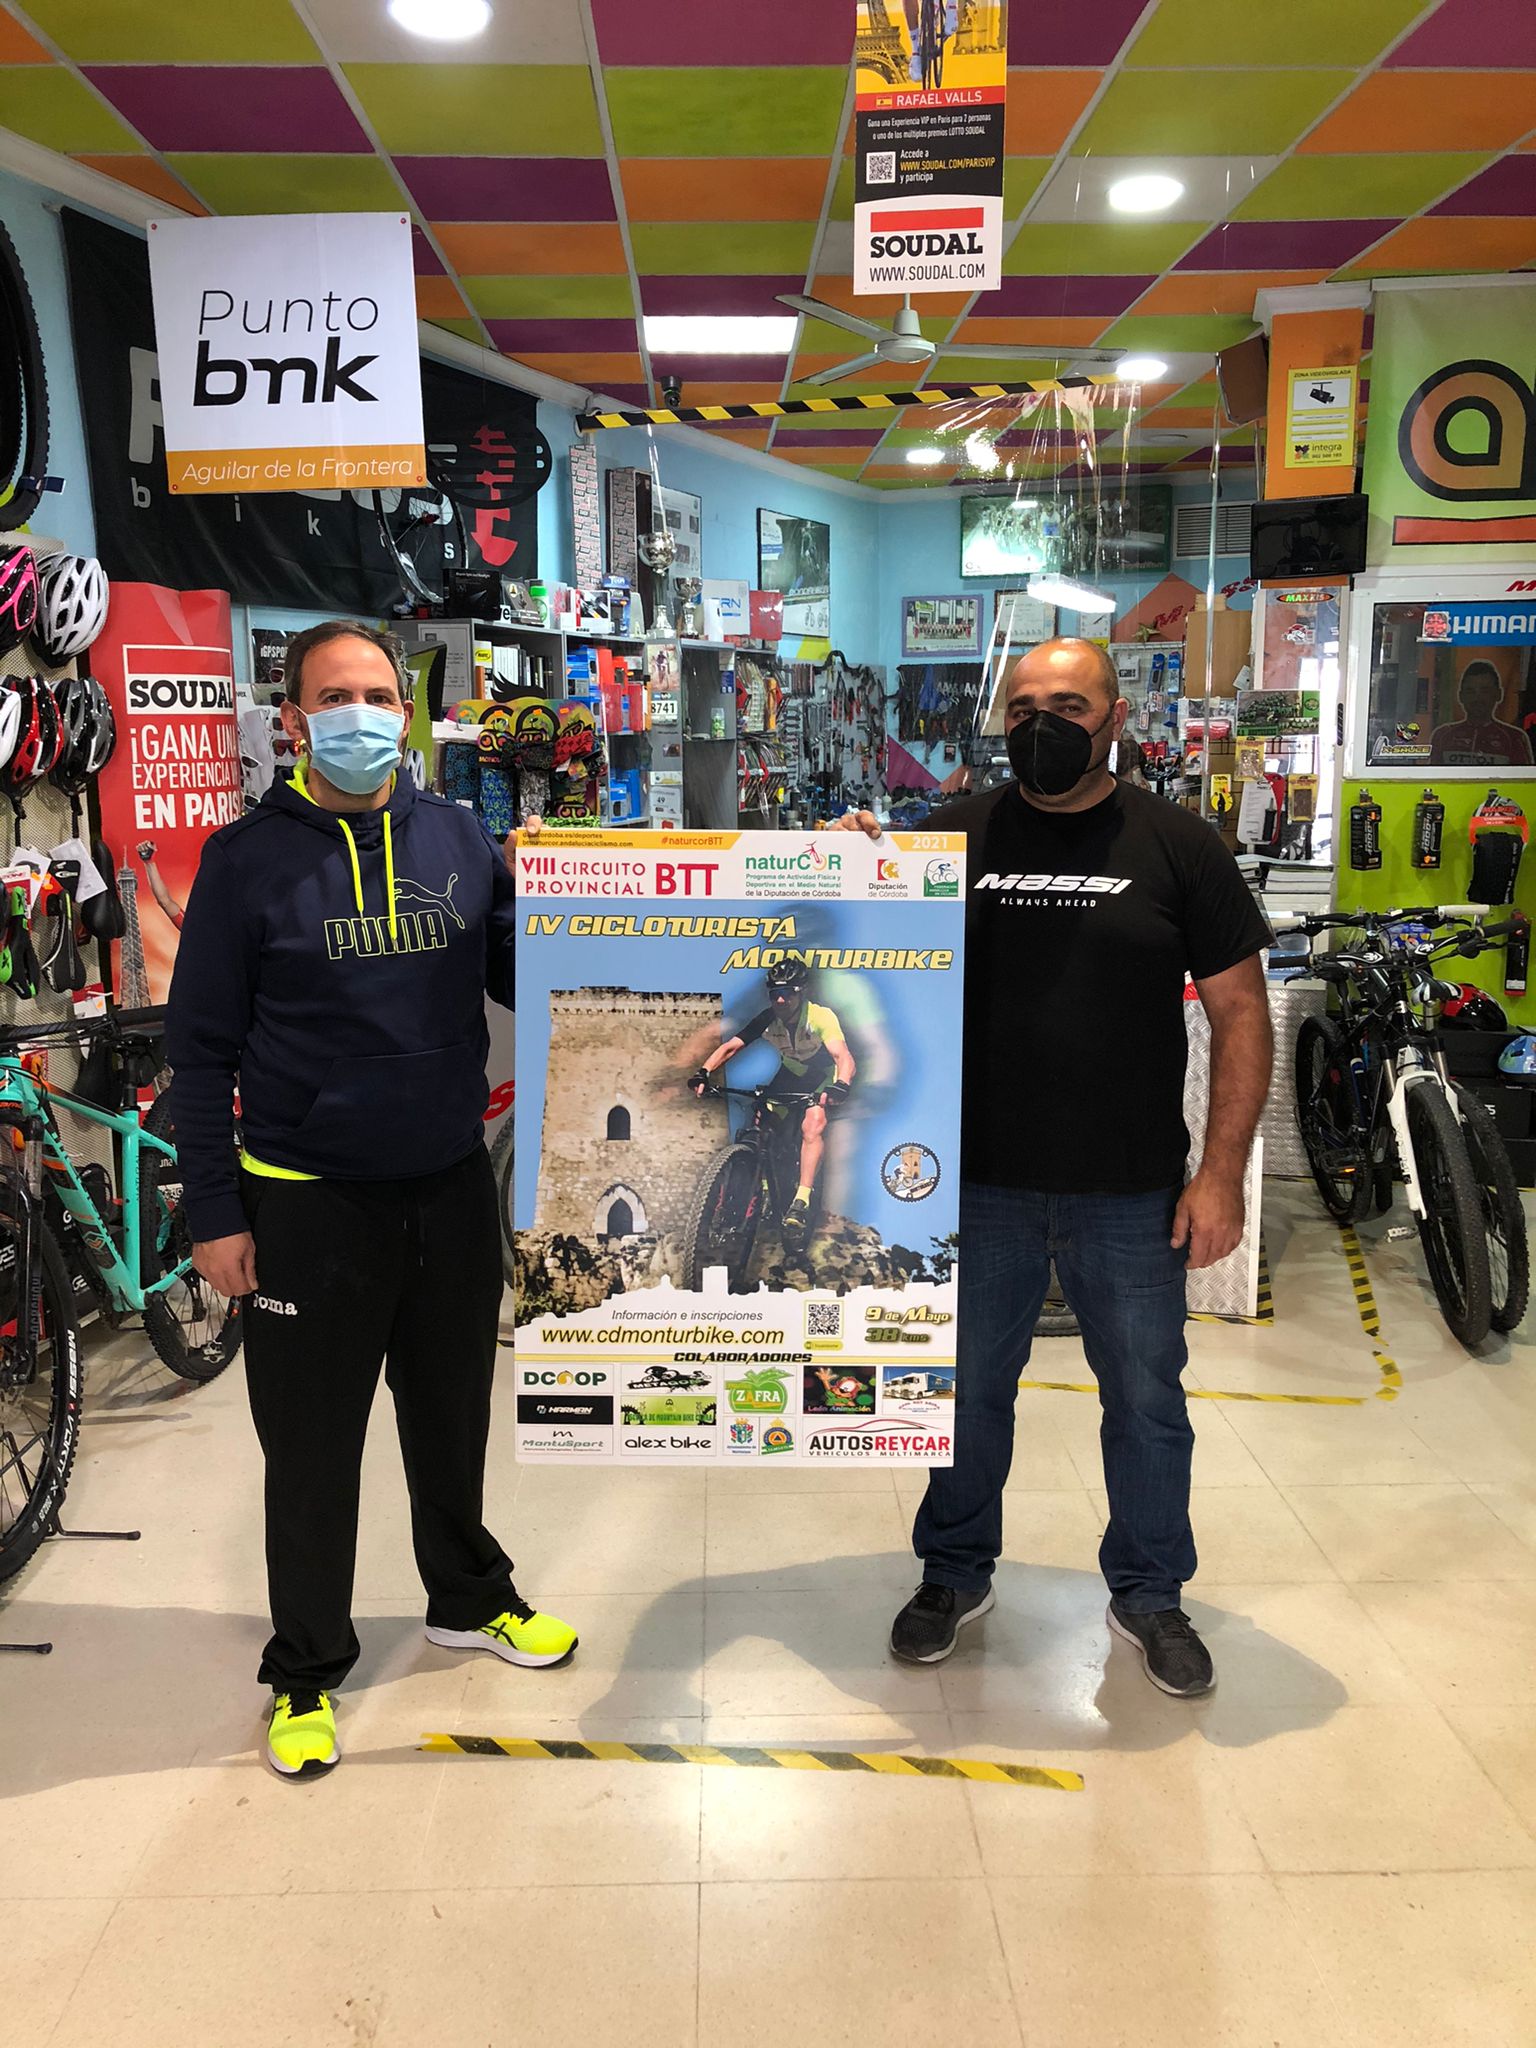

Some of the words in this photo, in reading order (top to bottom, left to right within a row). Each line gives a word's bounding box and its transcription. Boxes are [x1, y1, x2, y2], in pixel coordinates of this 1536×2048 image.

[896, 93, 942, 106] RAFAEL
[945, 91, 982, 103] VALLS
[892, 117, 920, 127] Experiencia
[921, 116, 930, 124] VIP
[968, 114, 992, 124] personas
[949, 127, 964, 136] LOTTO
[965, 126, 986, 135] SOUDAL
[900, 150, 924, 158] Accede
[905, 172, 934, 184] participa
[870, 232, 983, 259] SOUDAL
[869, 263, 985, 282] WWW.SOUDAL.COM
[199, 289, 378, 335] Punto
[1312, 444, 1342, 452] integra
[181, 460, 260, 484] Aguilar
[264, 459, 291, 479] de
[296, 458, 316, 477] la
[322, 457, 413, 478] Frontera
[1286, 594, 1324, 602] MAXXIS
[129, 679, 234, 708] SOUDAL
[650, 702, 675, 714] 8741
[130, 724, 213, 763] ¡GANA
[132, 763, 231, 789] EXPERIENCIA
[134, 794, 176, 829] EN
[661, 836, 724, 846] #naturcorBTT
[912, 836, 948, 849] 2021
[520, 858, 556, 875] VIII
[561, 862, 646, 876] CIRCUITO
[656, 863, 719, 896] BTT
[746, 882, 778, 890] Deportiva
[973, 873, 1133, 895] MASSI
[526, 880, 644, 896] PROVINCIAL
[764, 889, 800, 898] Diputación
[812, 888, 842, 898] Córdoba
[868, 882, 908, 892] Diputación
[878, 890, 908, 898] Córdoba
[1000, 897, 1049, 906] ALWAYS
[1056, 899, 1097, 908] AHEAD
[324, 909, 448, 960] PUMA
[525, 914, 565, 936] IV
[568, 914, 797, 943] CICLOTURISTA
[612, 1310, 676, 1321] Información
[680, 1312, 688, 1320] e
[690, 1310, 763, 1322] inscripciones
[865, 1306, 882, 1321] 9
[884, 1310, 899, 1322] de
[900, 1304, 952, 1324] Mayo
[542, 1326, 785, 1344] www.cdmonturbike.com
[865, 1327, 901, 1343] 38
[901, 1330, 930, 1342] kms
[674, 1352, 813, 1364] COLABORADORES
[736, 1390, 781, 1402] ZAFRA
[624, 1436, 666, 1449] alex
[670, 1436, 712, 1449] bike
